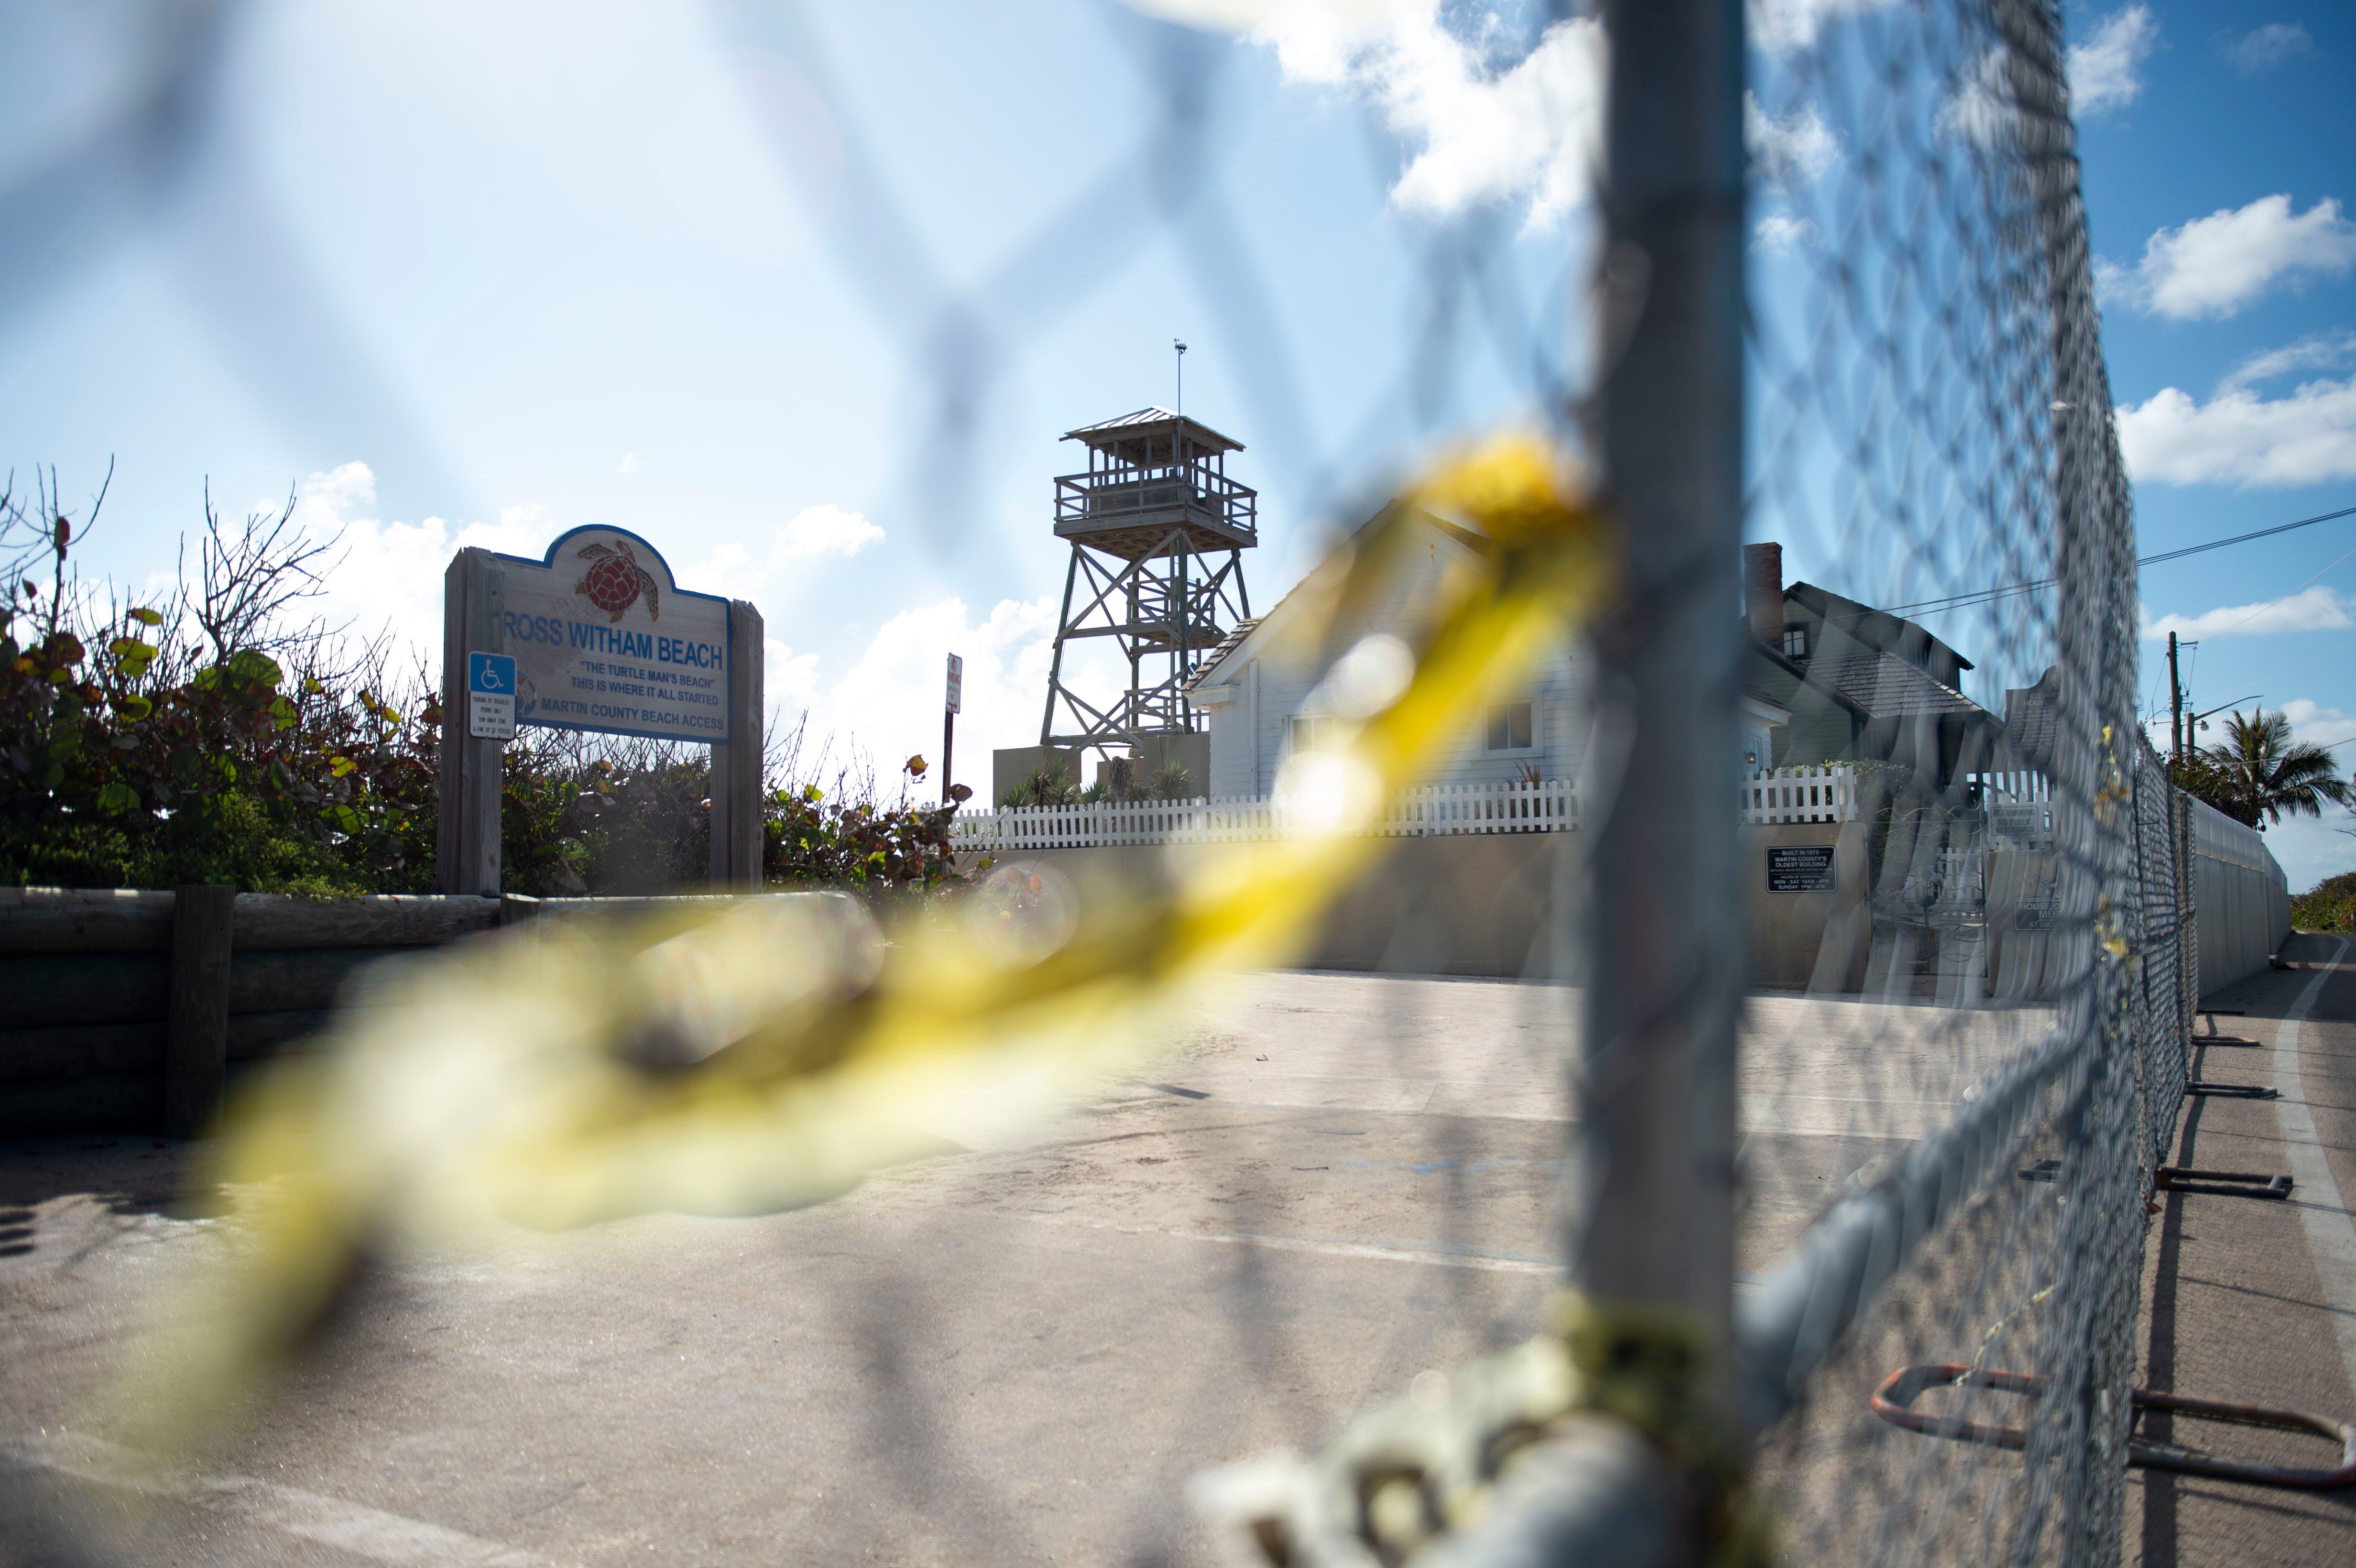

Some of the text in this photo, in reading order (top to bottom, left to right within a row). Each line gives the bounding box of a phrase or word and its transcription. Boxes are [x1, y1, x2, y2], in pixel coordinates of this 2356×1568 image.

[504, 611, 722, 670] ROSS WITHAM BEACH
[580, 661, 715, 689] "THE TURTLE MAN'S BEACH"
[571, 676, 719, 706] THIS IS WHERE IT ALL STARTED
[542, 697, 724, 730] MARTIN COUNTY BEACH ACCESS
